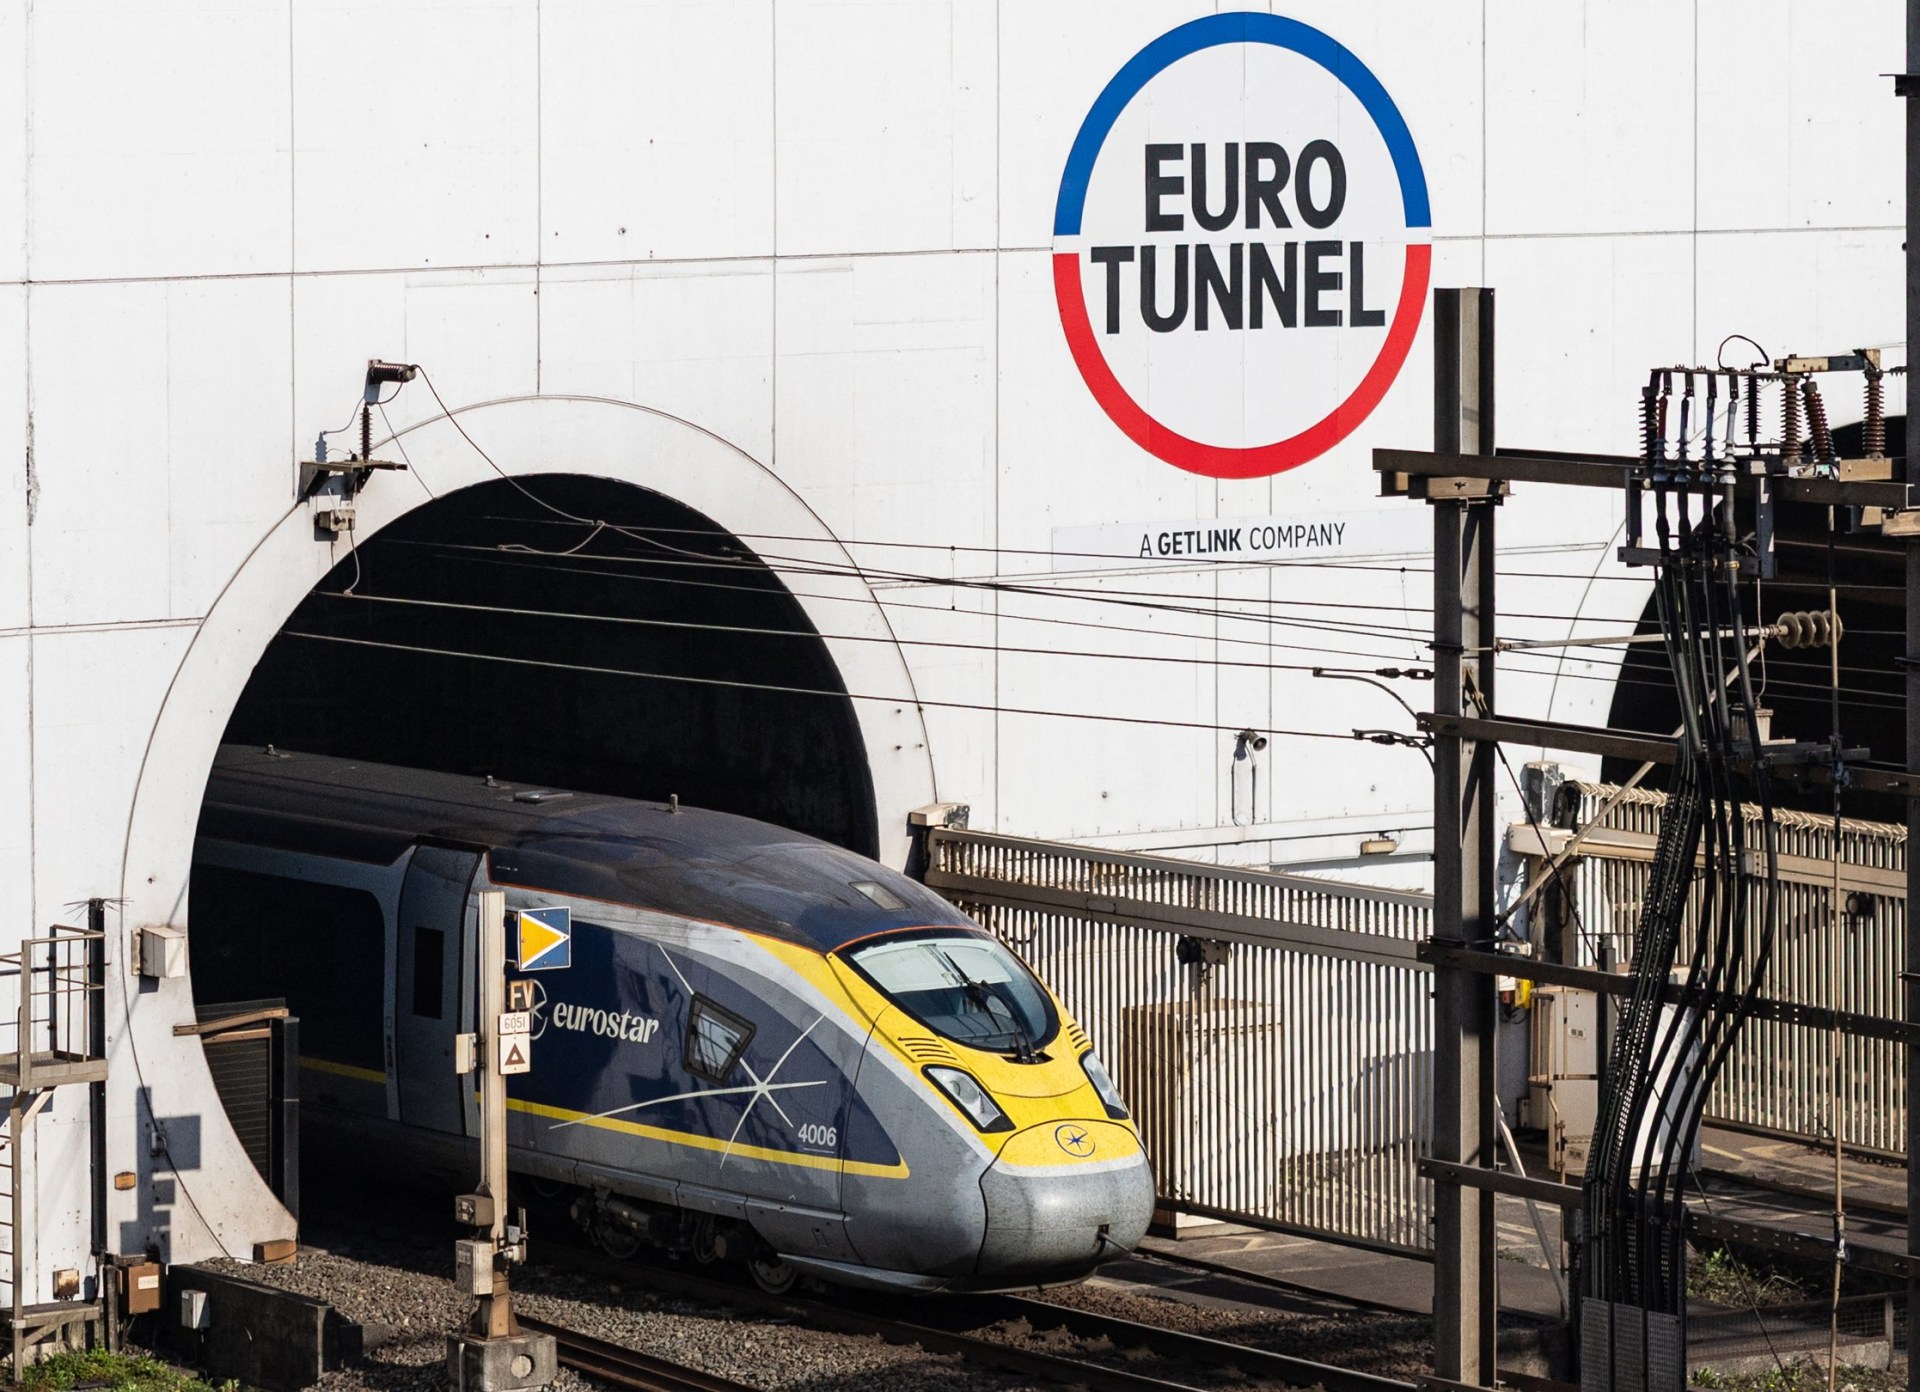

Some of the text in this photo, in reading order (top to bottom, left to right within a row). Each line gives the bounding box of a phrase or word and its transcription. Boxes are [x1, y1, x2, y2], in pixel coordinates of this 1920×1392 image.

[1145, 139, 1347, 232] EURO
[1091, 240, 1386, 334] TUNNEL
[1139, 522, 1346, 557] A GETLINK COMPANY
[510, 980, 534, 1010] FV
[504, 1016, 526, 1029] 6051
[553, 1002, 659, 1044] eurostar
[798, 1123, 837, 1147] 4006
